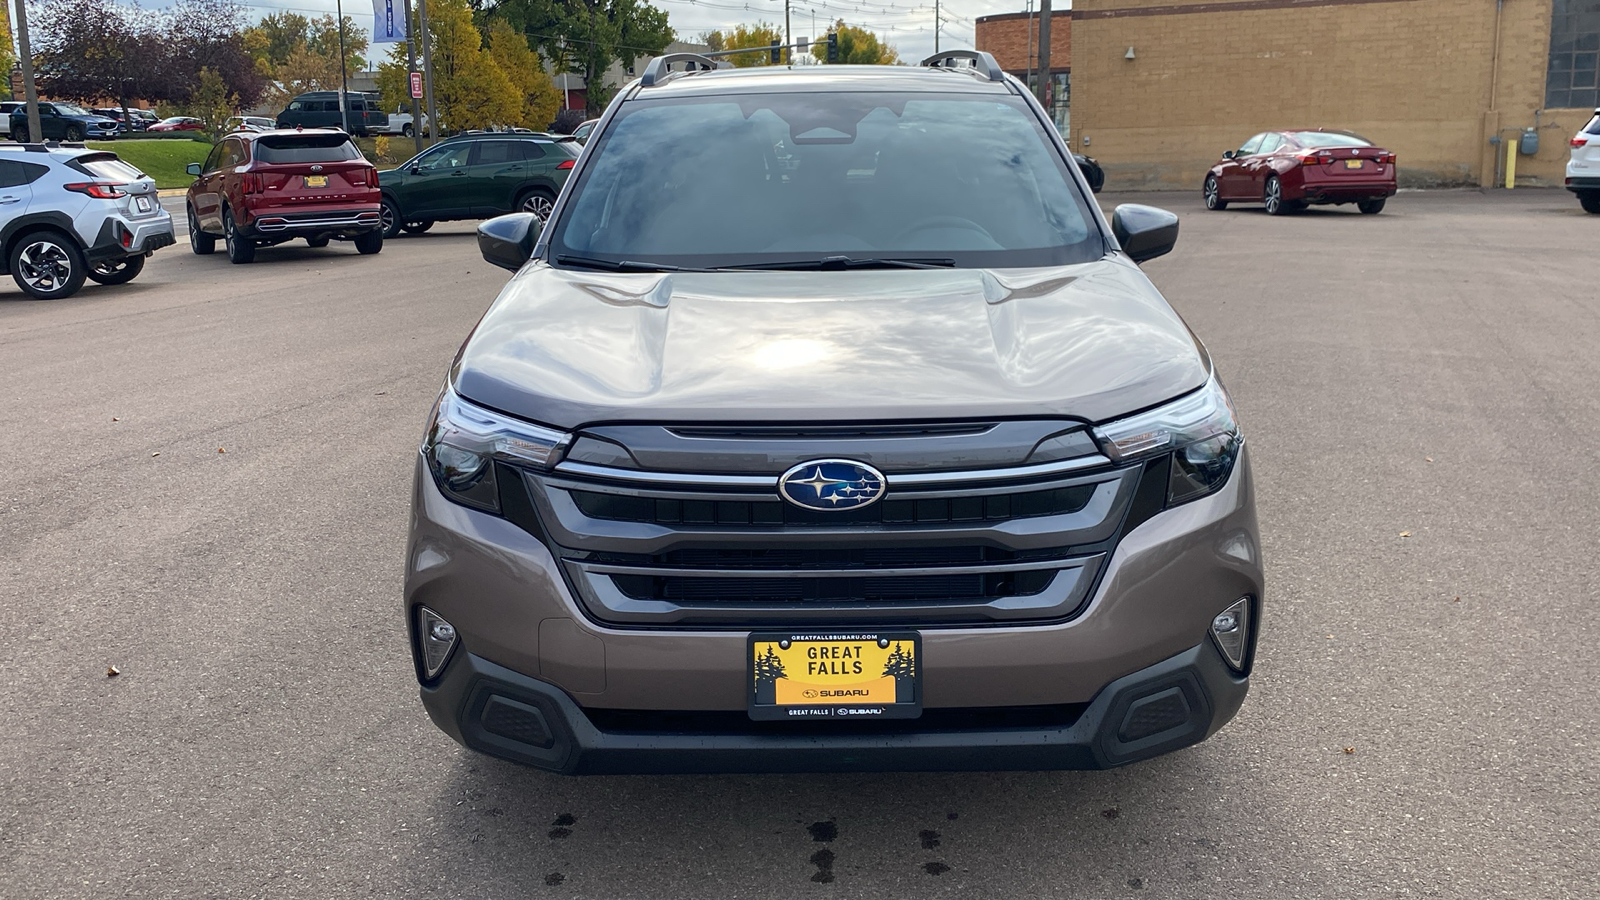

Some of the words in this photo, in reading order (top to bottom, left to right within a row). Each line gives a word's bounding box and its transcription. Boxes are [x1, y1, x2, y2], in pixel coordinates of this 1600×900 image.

[807, 646, 862, 660] GREAT
[808, 660, 863, 675] FALLS
[820, 689, 869, 697] SUBARU
